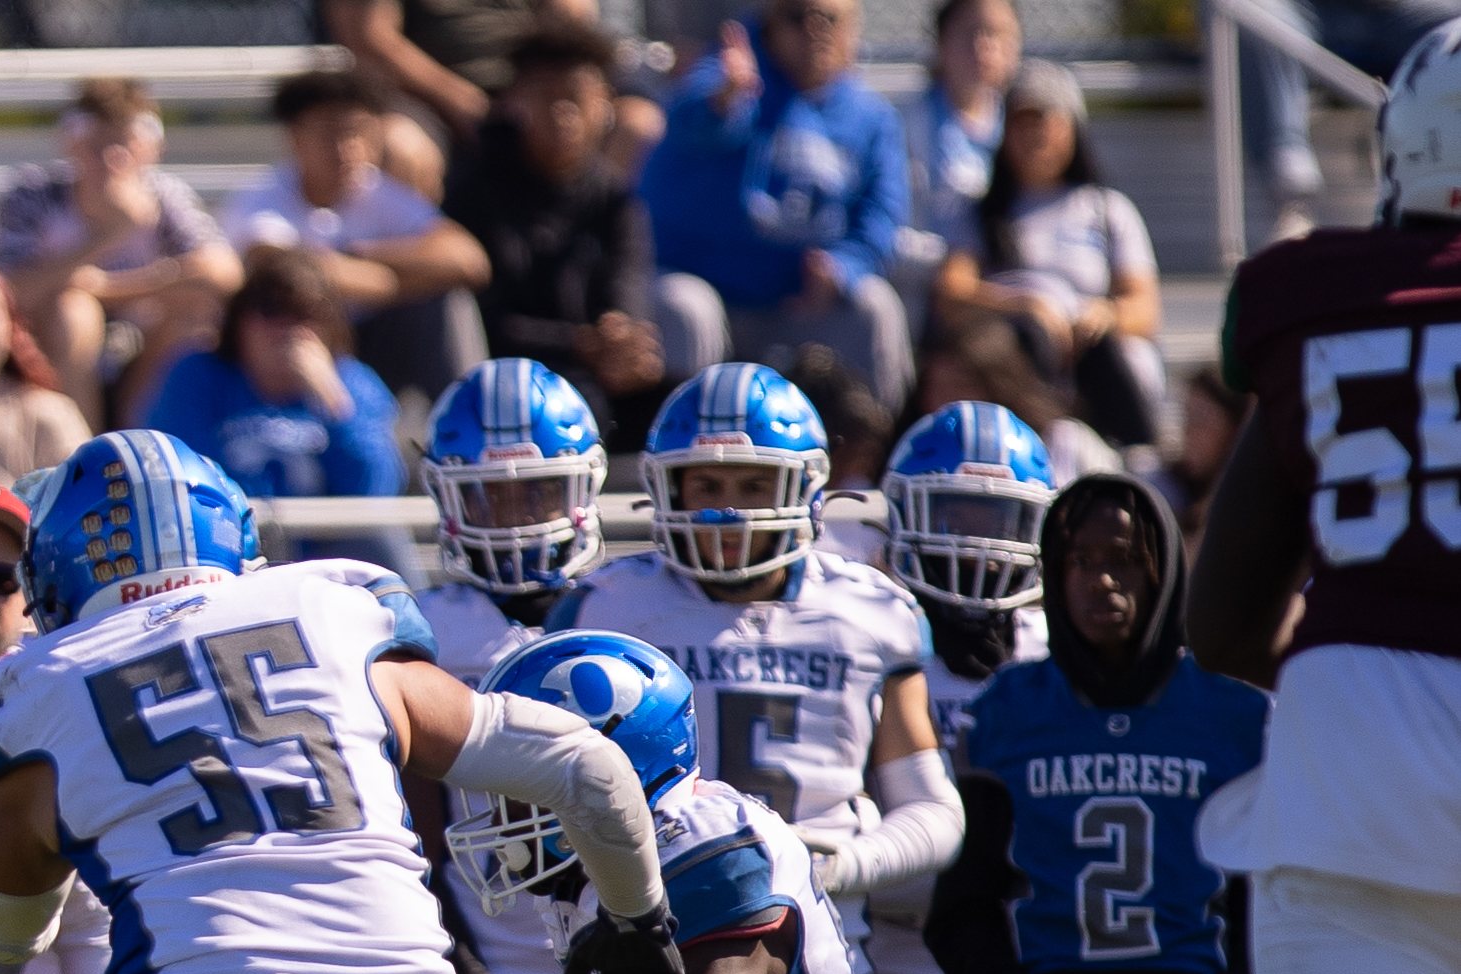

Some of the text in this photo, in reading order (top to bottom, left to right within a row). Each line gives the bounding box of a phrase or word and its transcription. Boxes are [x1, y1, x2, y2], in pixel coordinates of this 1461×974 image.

[84, 617, 368, 857] 55
[1027, 753, 1207, 799] OAKCREST
[1074, 796, 1161, 962] 2
